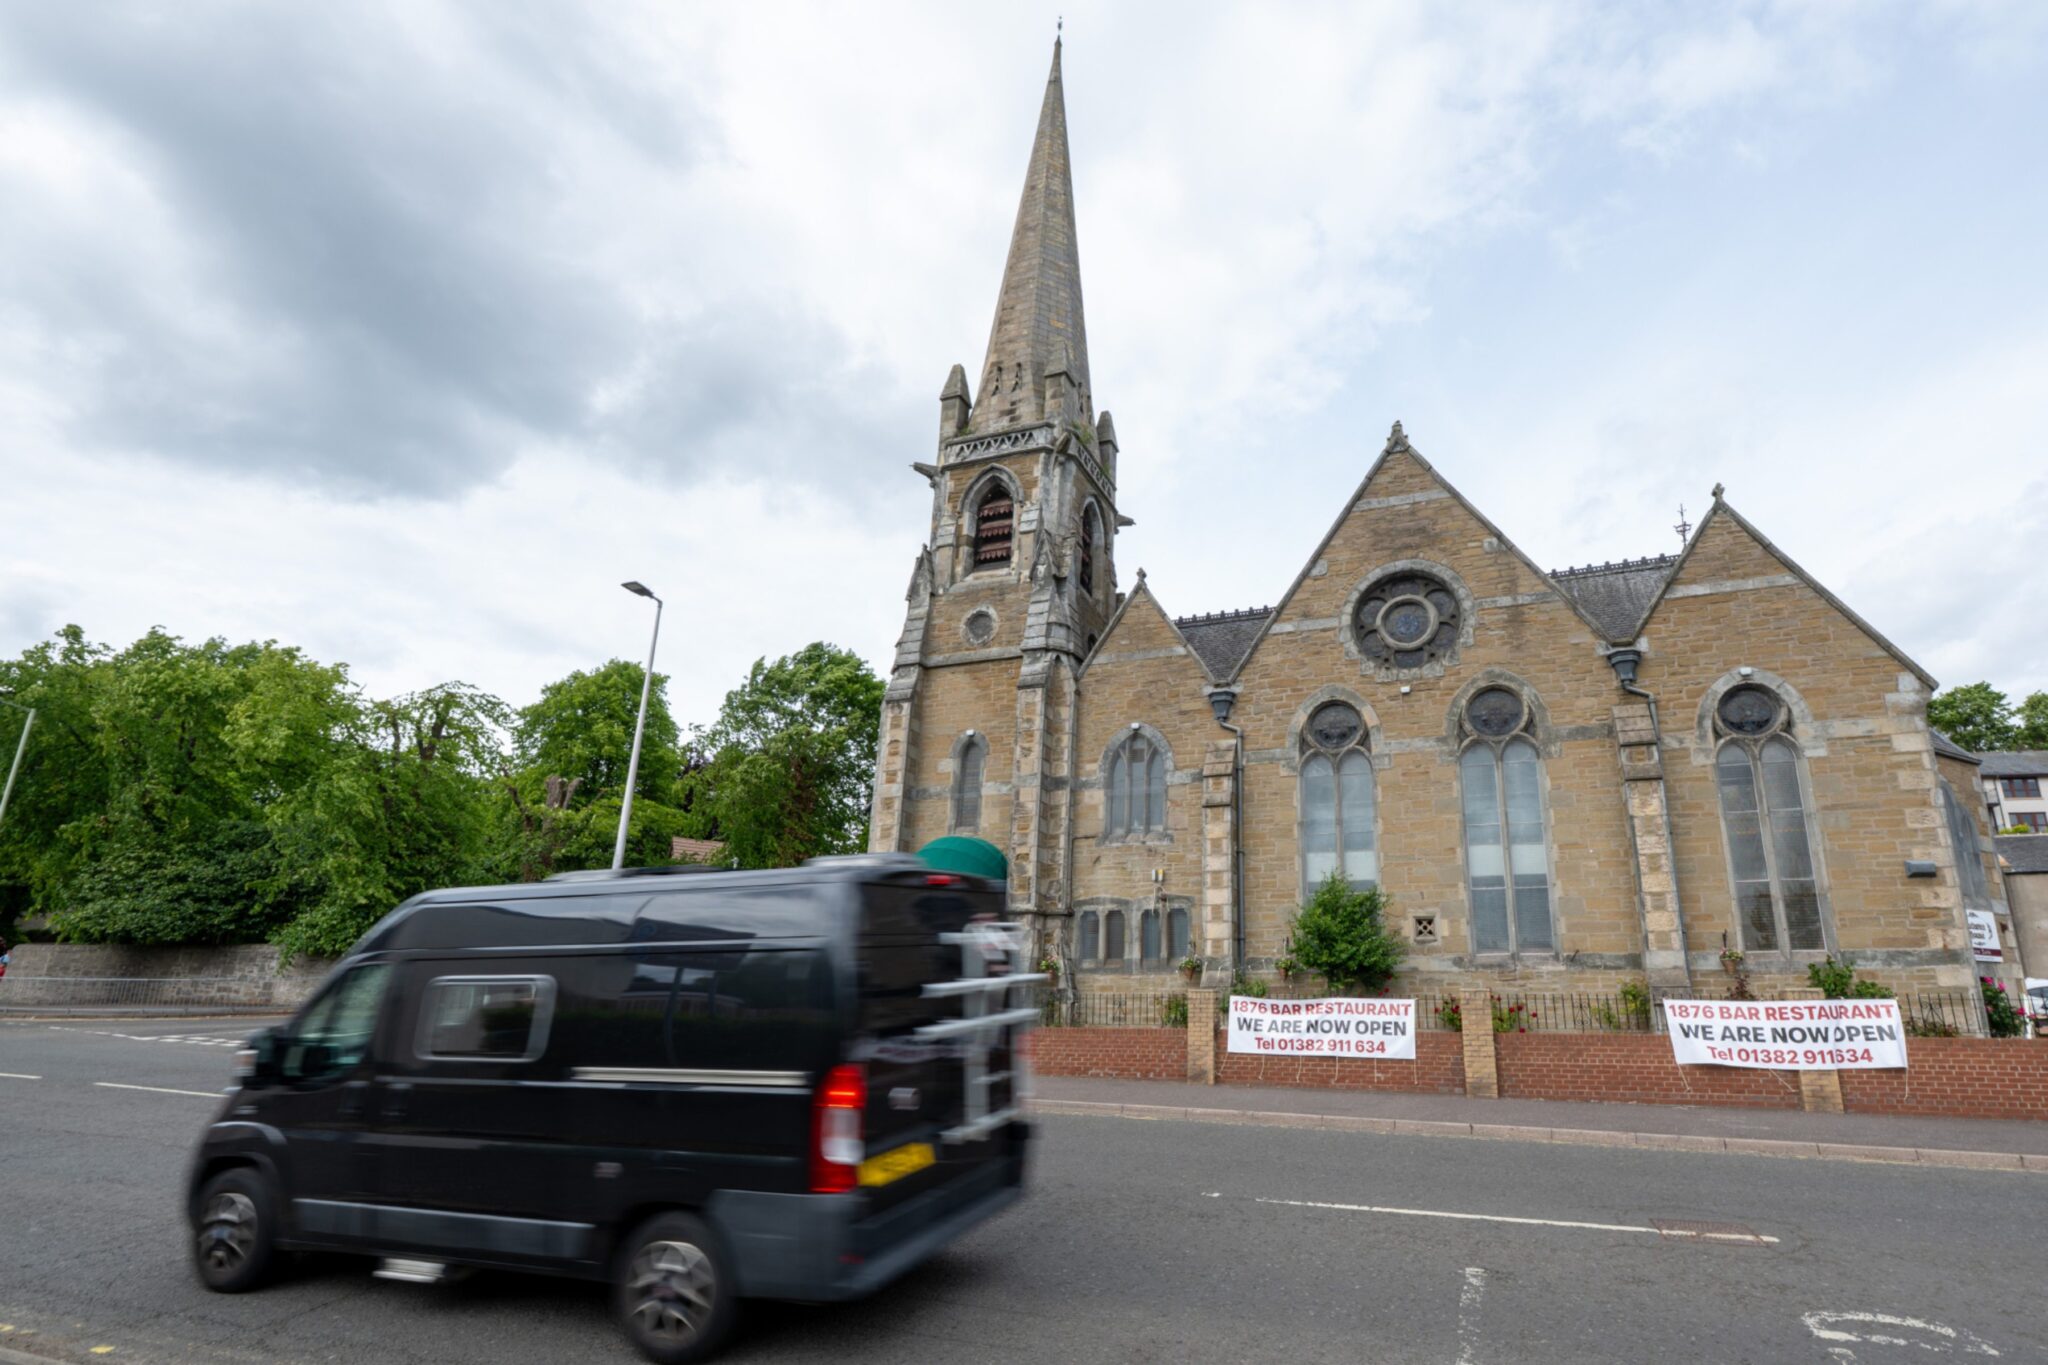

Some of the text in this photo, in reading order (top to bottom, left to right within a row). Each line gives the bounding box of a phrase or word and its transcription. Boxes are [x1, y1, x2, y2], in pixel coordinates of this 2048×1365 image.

[1232, 1001, 1412, 1016] 1876 BAR RESTAURANT
[1669, 1004, 1894, 1021] 1876 BAR RESTAURANT
[1237, 1017, 1406, 1036] WE ARE NOW OPEN
[1679, 1023, 1896, 1043] WE ARE NOW OPEN
[1255, 1037, 1386, 1053] Tel 01382 911 634
[1706, 1045, 1873, 1064] Tel 01382 911 634
